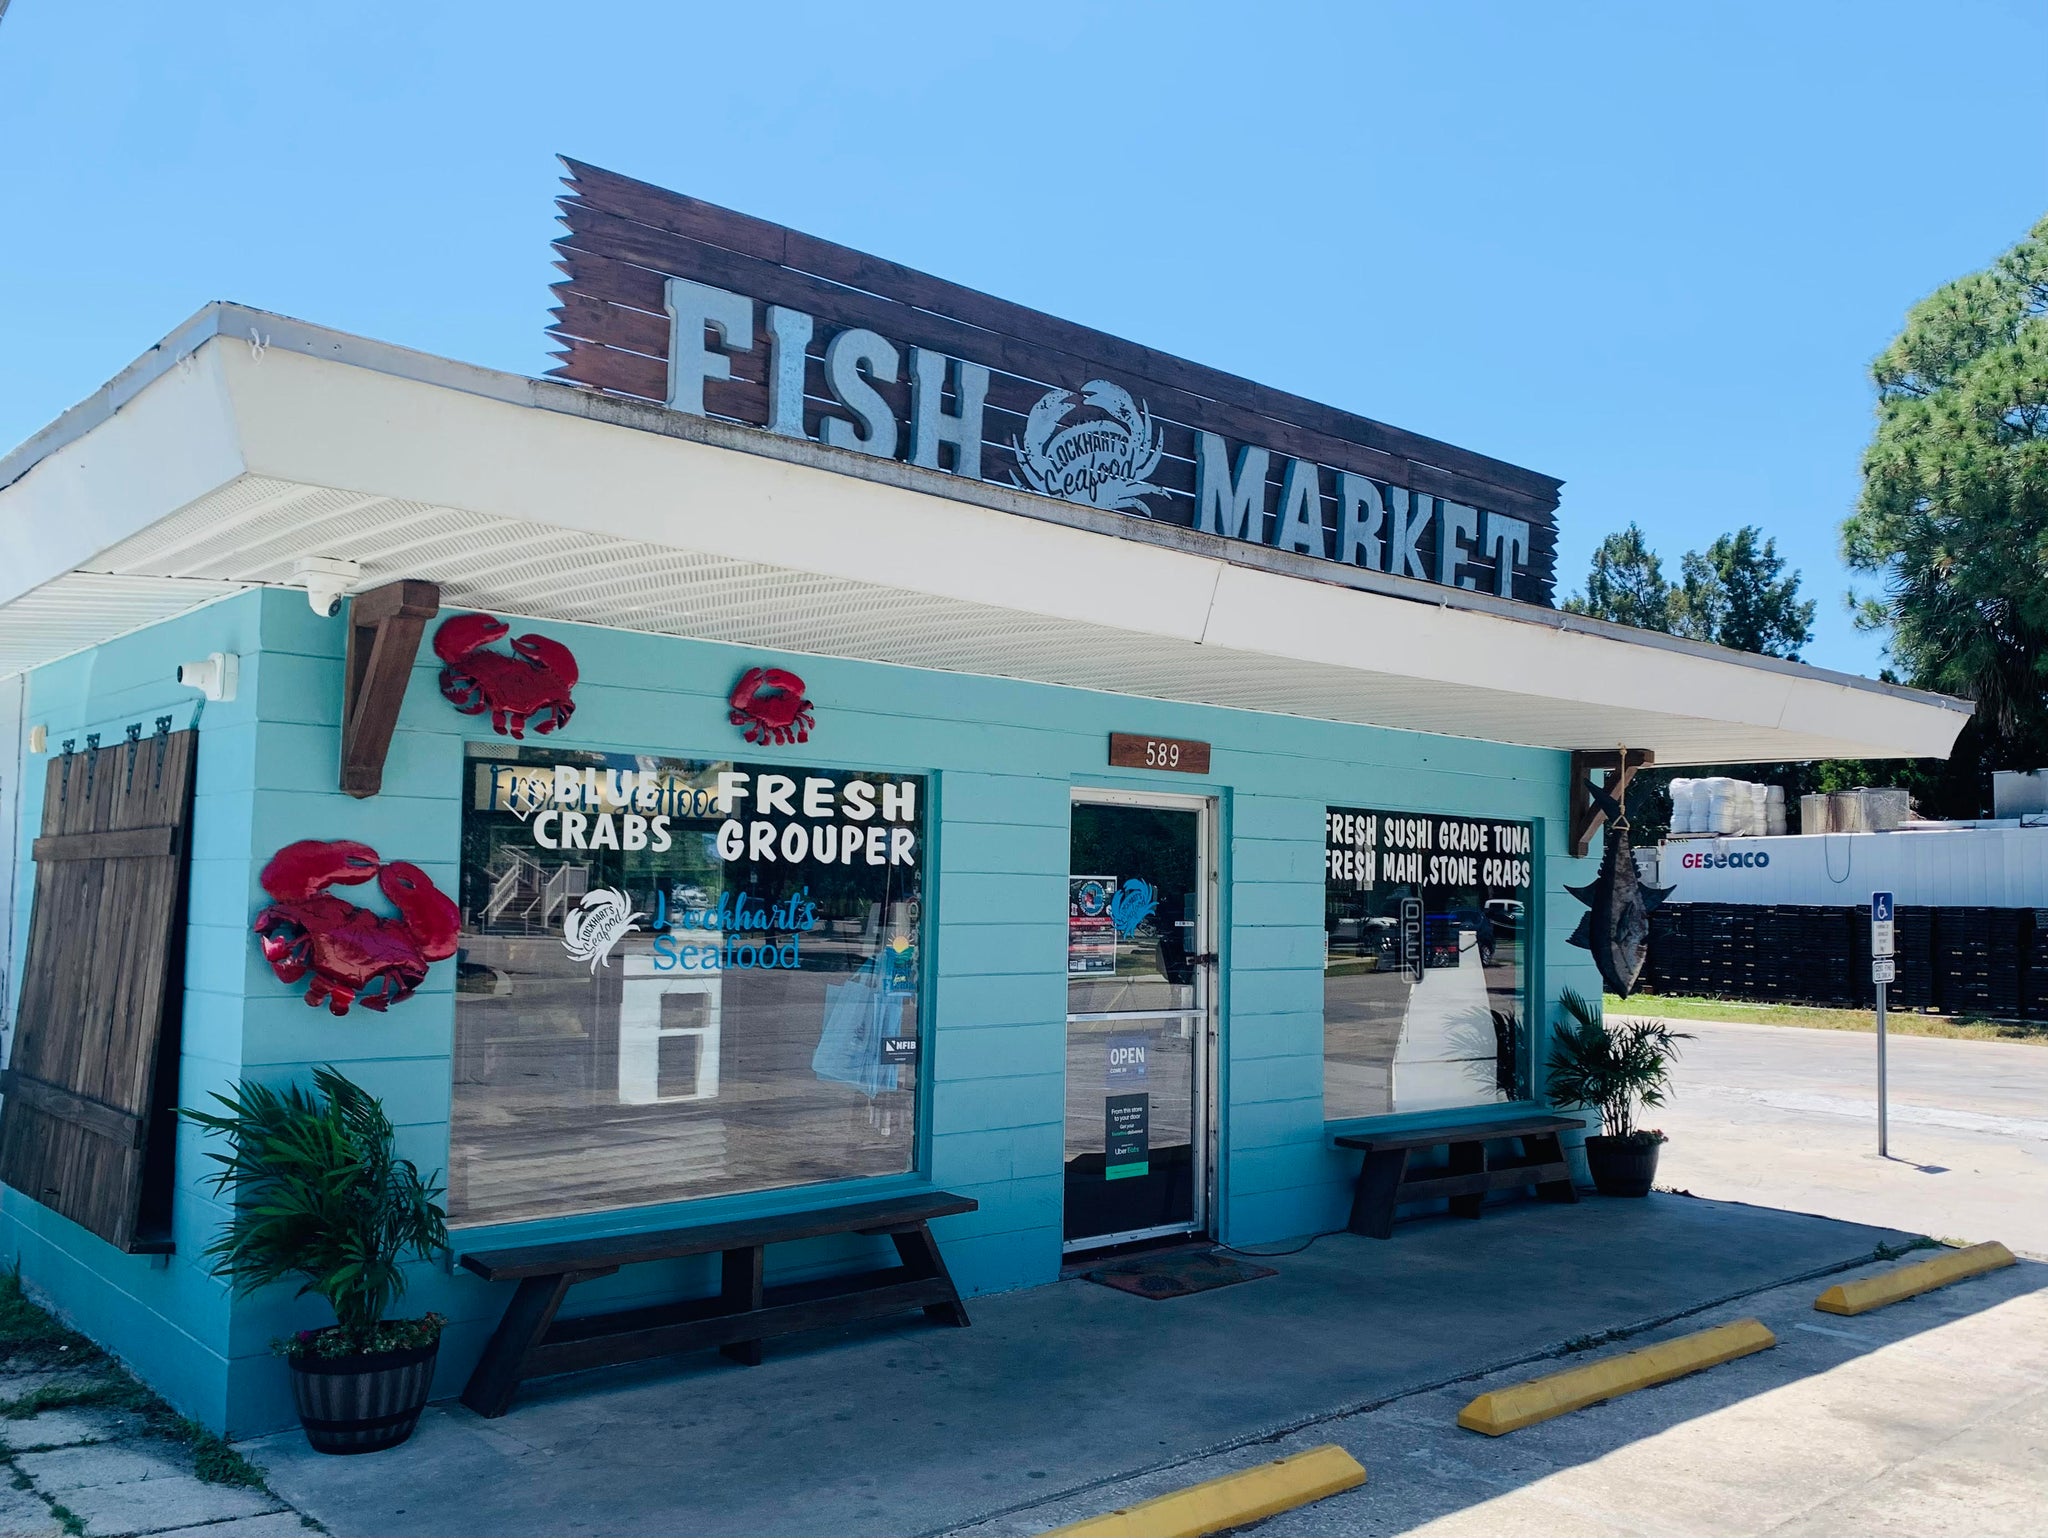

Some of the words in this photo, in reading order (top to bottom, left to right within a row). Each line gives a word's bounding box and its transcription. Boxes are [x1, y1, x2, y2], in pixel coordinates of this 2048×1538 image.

[664, 278, 990, 481] FISH
[1193, 430, 1530, 599] MARKET
[1049, 430, 1129, 474] LOCKHART'S
[1044, 448, 1137, 503] Seafood
[1145, 741, 1180, 768] 589
[555, 765, 657, 807] BLUE
[718, 772, 916, 822] FRESH
[533, 810, 672, 853] CRABS
[717, 819, 915, 867] GROUPER
[1384, 817, 1432, 850] SUSHI
[1439, 821, 1488, 853] GRADE
[1493, 825, 1530, 855] TUNA
[1483, 858, 1530, 889] CRABS
[1682, 852, 1770, 869] GEseaco
[581, 906, 615, 942] LOCKHART'S
[653, 886, 820, 933] Lockhart's
[583, 908, 622, 954] Seafood
[653, 933, 801, 971] Seafood
[1405, 903, 1420, 979] OPEN
[896, 1041, 917, 1050] NFIB
[1110, 1047, 1145, 1066] OPEN
[1114, 1148, 1127, 1156] Uber
